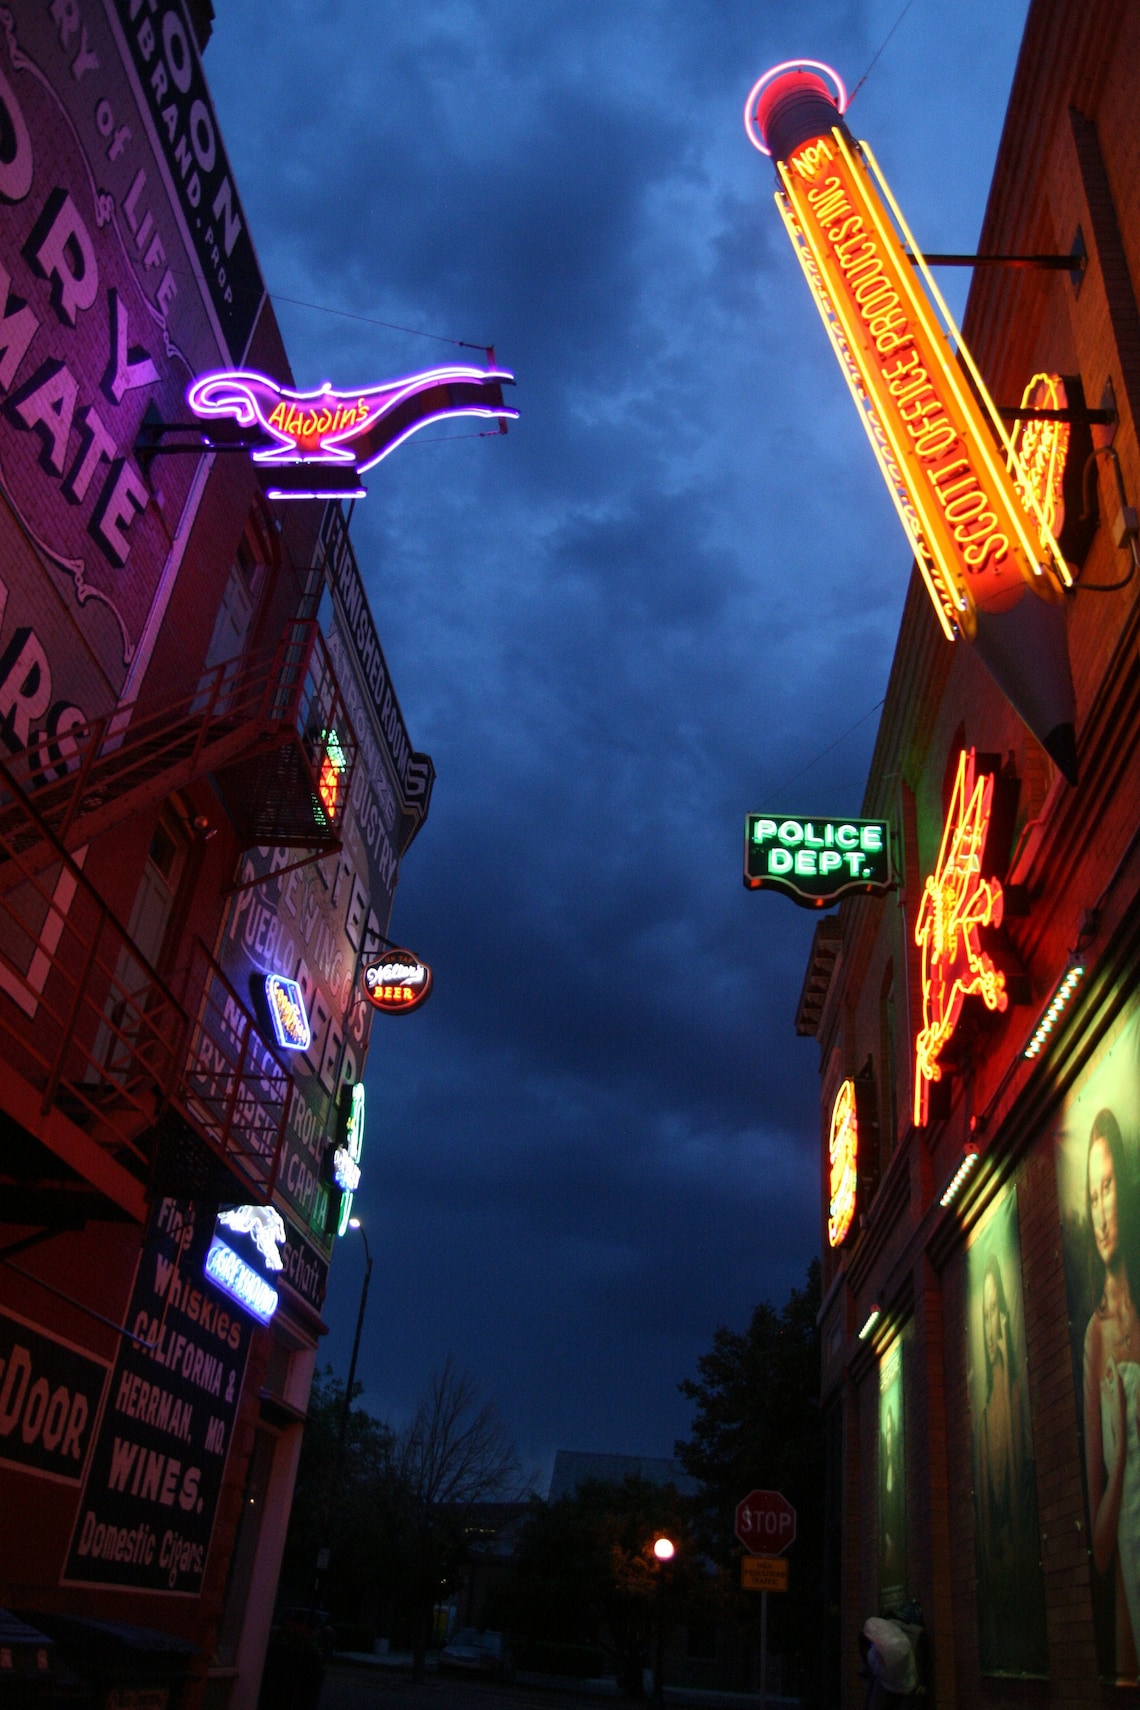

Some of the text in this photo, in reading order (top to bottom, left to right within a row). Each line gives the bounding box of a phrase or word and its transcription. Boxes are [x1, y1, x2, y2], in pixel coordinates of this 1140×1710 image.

[129, 0, 202, 228] BRAND.
[150, 0, 242, 258] OON
[95, 98, 132, 162] of
[121, 168, 178, 318] LIFE
[827, 215, 915, 354] PRODUCTS
[268, 397, 370, 436] Aladdin's
[882, 350, 958, 457] OFFICE
[926, 458, 1010, 565] SCOTT
[381, 687, 429, 796] ROOMS
[753, 819, 883, 851] POLICE
[767, 848, 873, 878] DEPT.
[373, 985, 414, 1000] BEER
[153, 1252, 242, 1350] Whiskies
[131, 1309, 237, 1404] CALIFORNIA &
[77, 1510, 156, 1567] Domestic
[741, 1508, 792, 1535] STOP
